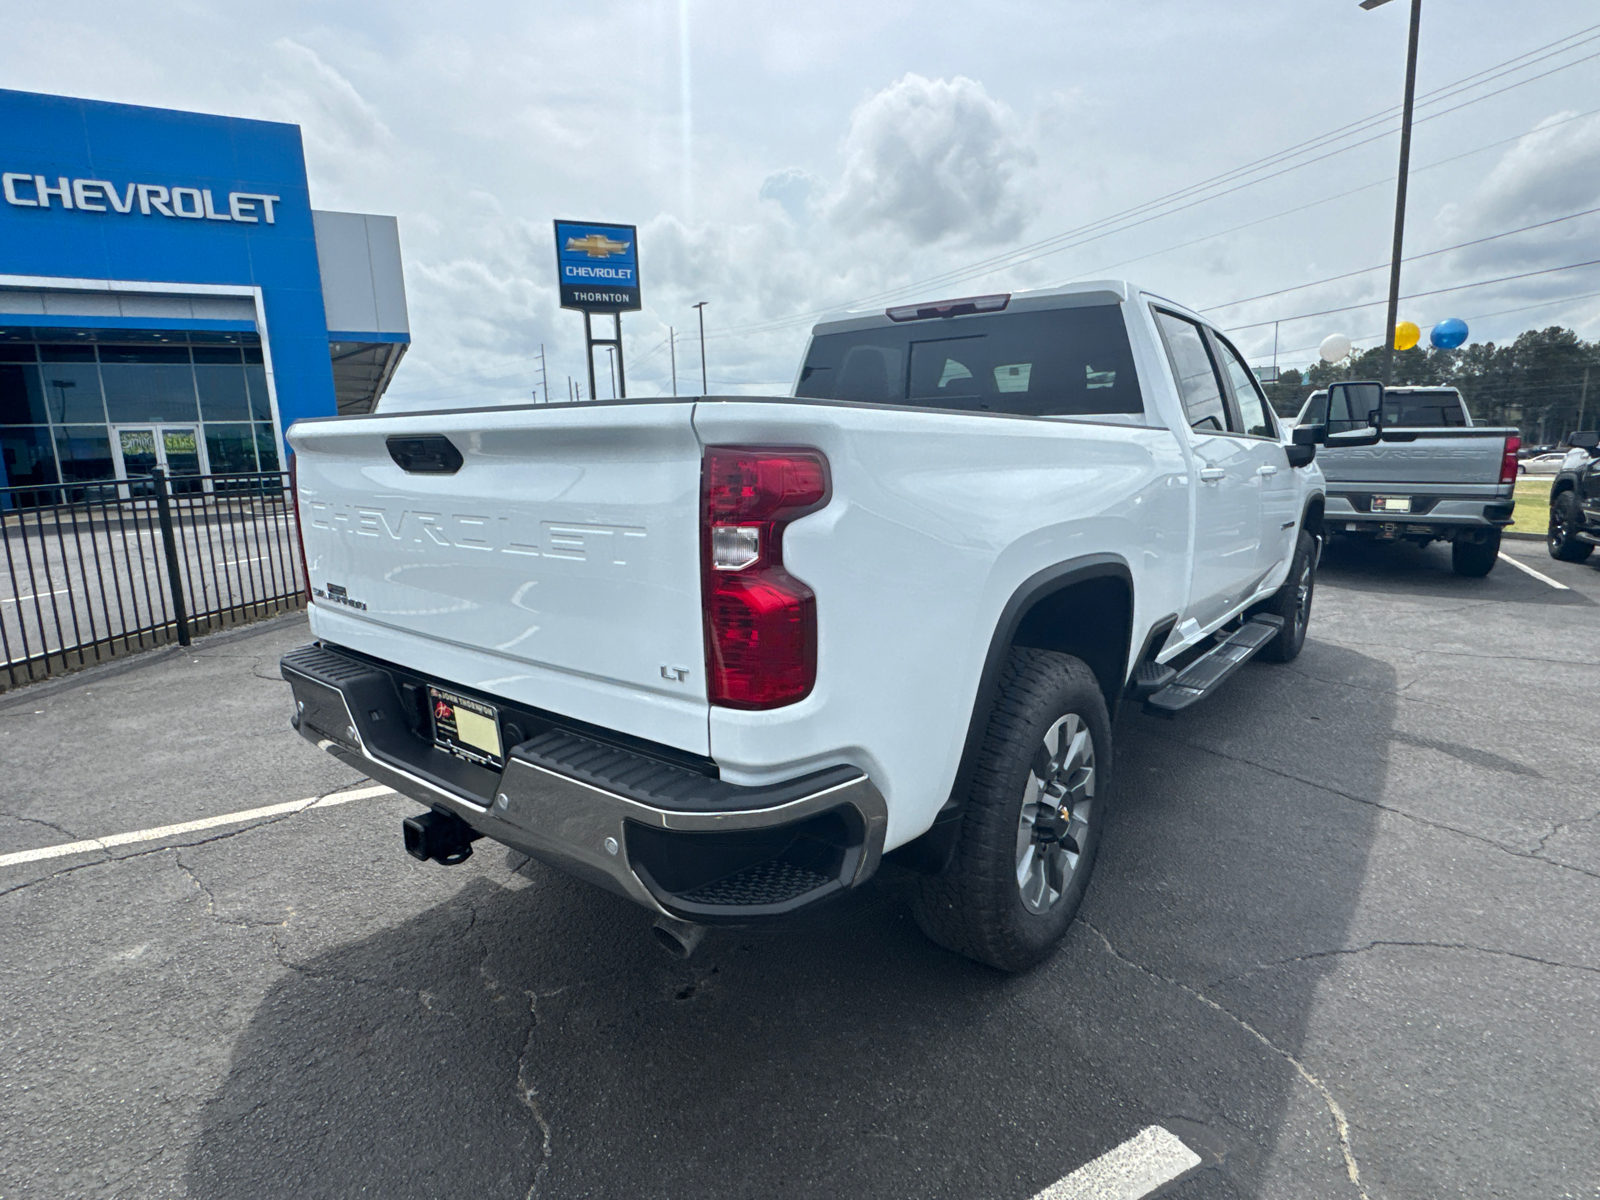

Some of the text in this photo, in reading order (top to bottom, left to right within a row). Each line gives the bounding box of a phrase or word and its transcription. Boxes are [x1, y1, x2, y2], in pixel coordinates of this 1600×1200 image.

[2, 172, 280, 224] CHEVROLET
[565, 265, 632, 279] CHEVROLET
[573, 291, 630, 302] THORNTON
[309, 501, 647, 564] CHEVROLET
[660, 665, 690, 682] LT
